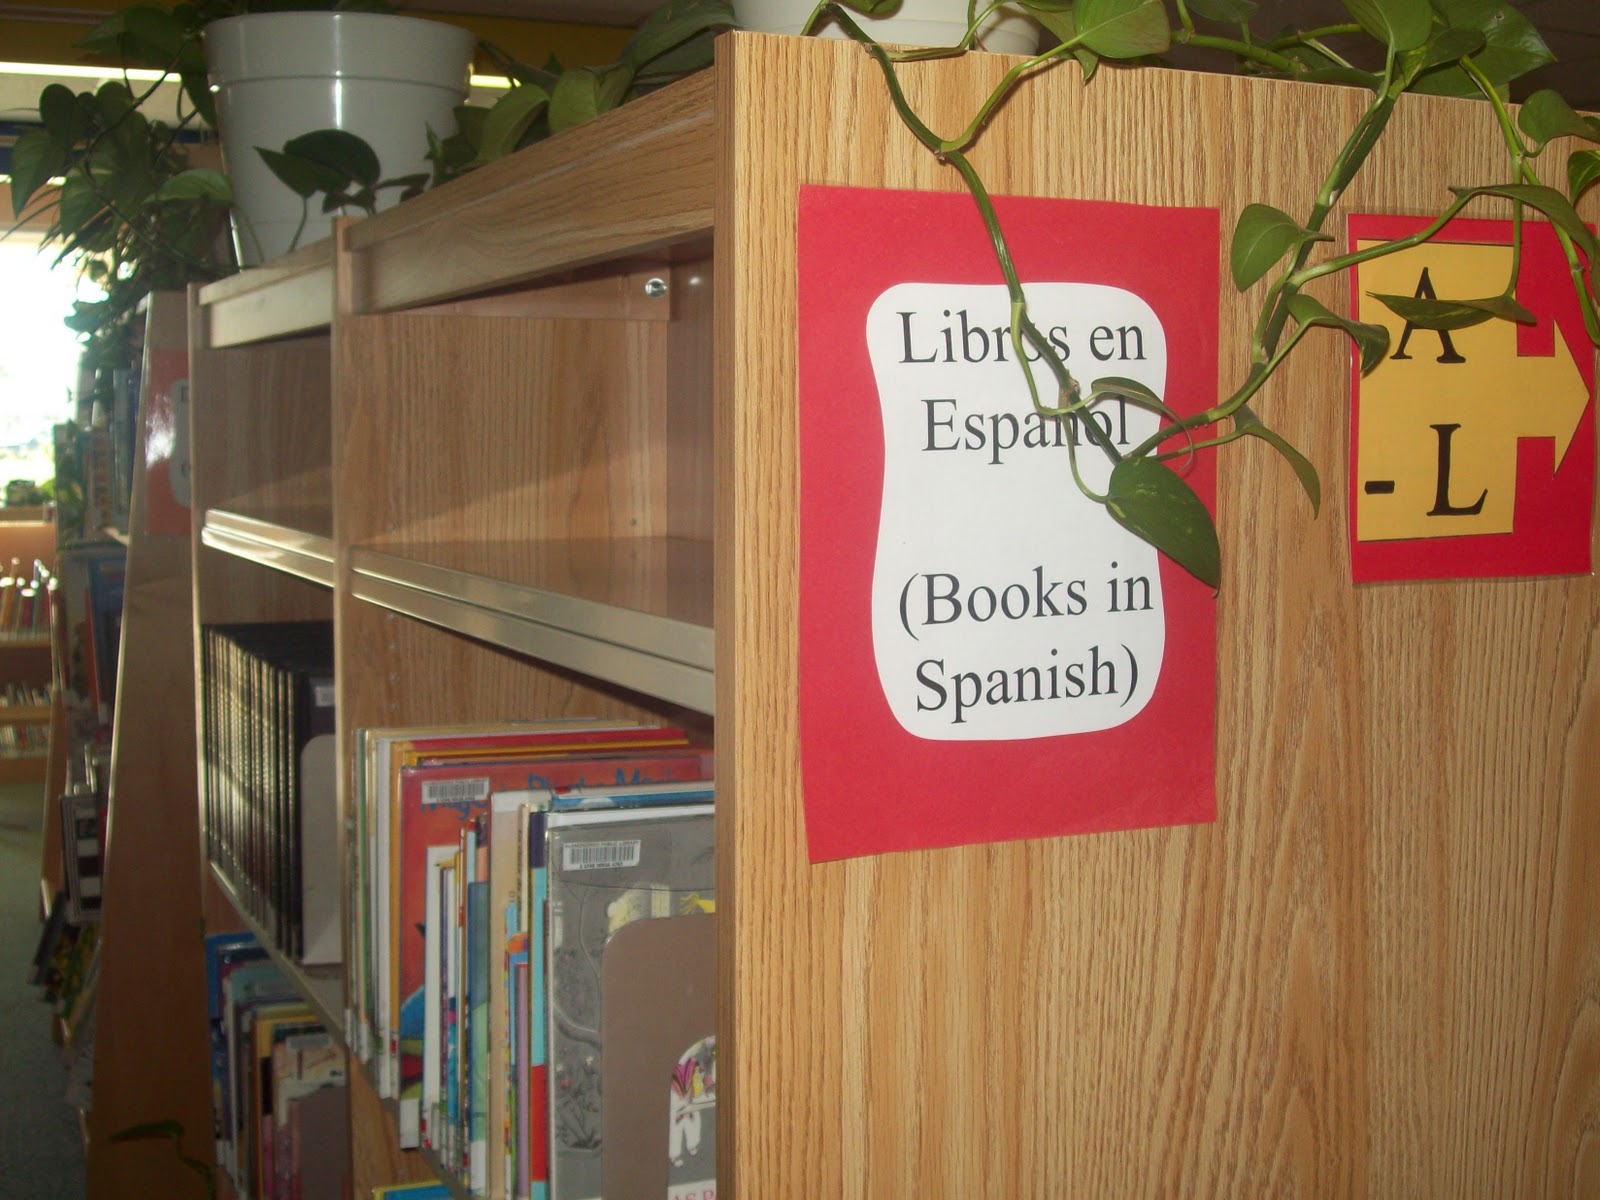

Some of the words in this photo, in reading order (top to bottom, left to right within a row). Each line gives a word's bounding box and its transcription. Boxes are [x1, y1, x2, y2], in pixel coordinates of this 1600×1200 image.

[896, 309, 1071, 363] Librs
[1089, 323, 1147, 361] en
[1389, 266, 1466, 363] A
[899, 565, 1088, 641] (Books
[1106, 561, 1154, 613] in
[916, 643, 1138, 724] Spanish)
